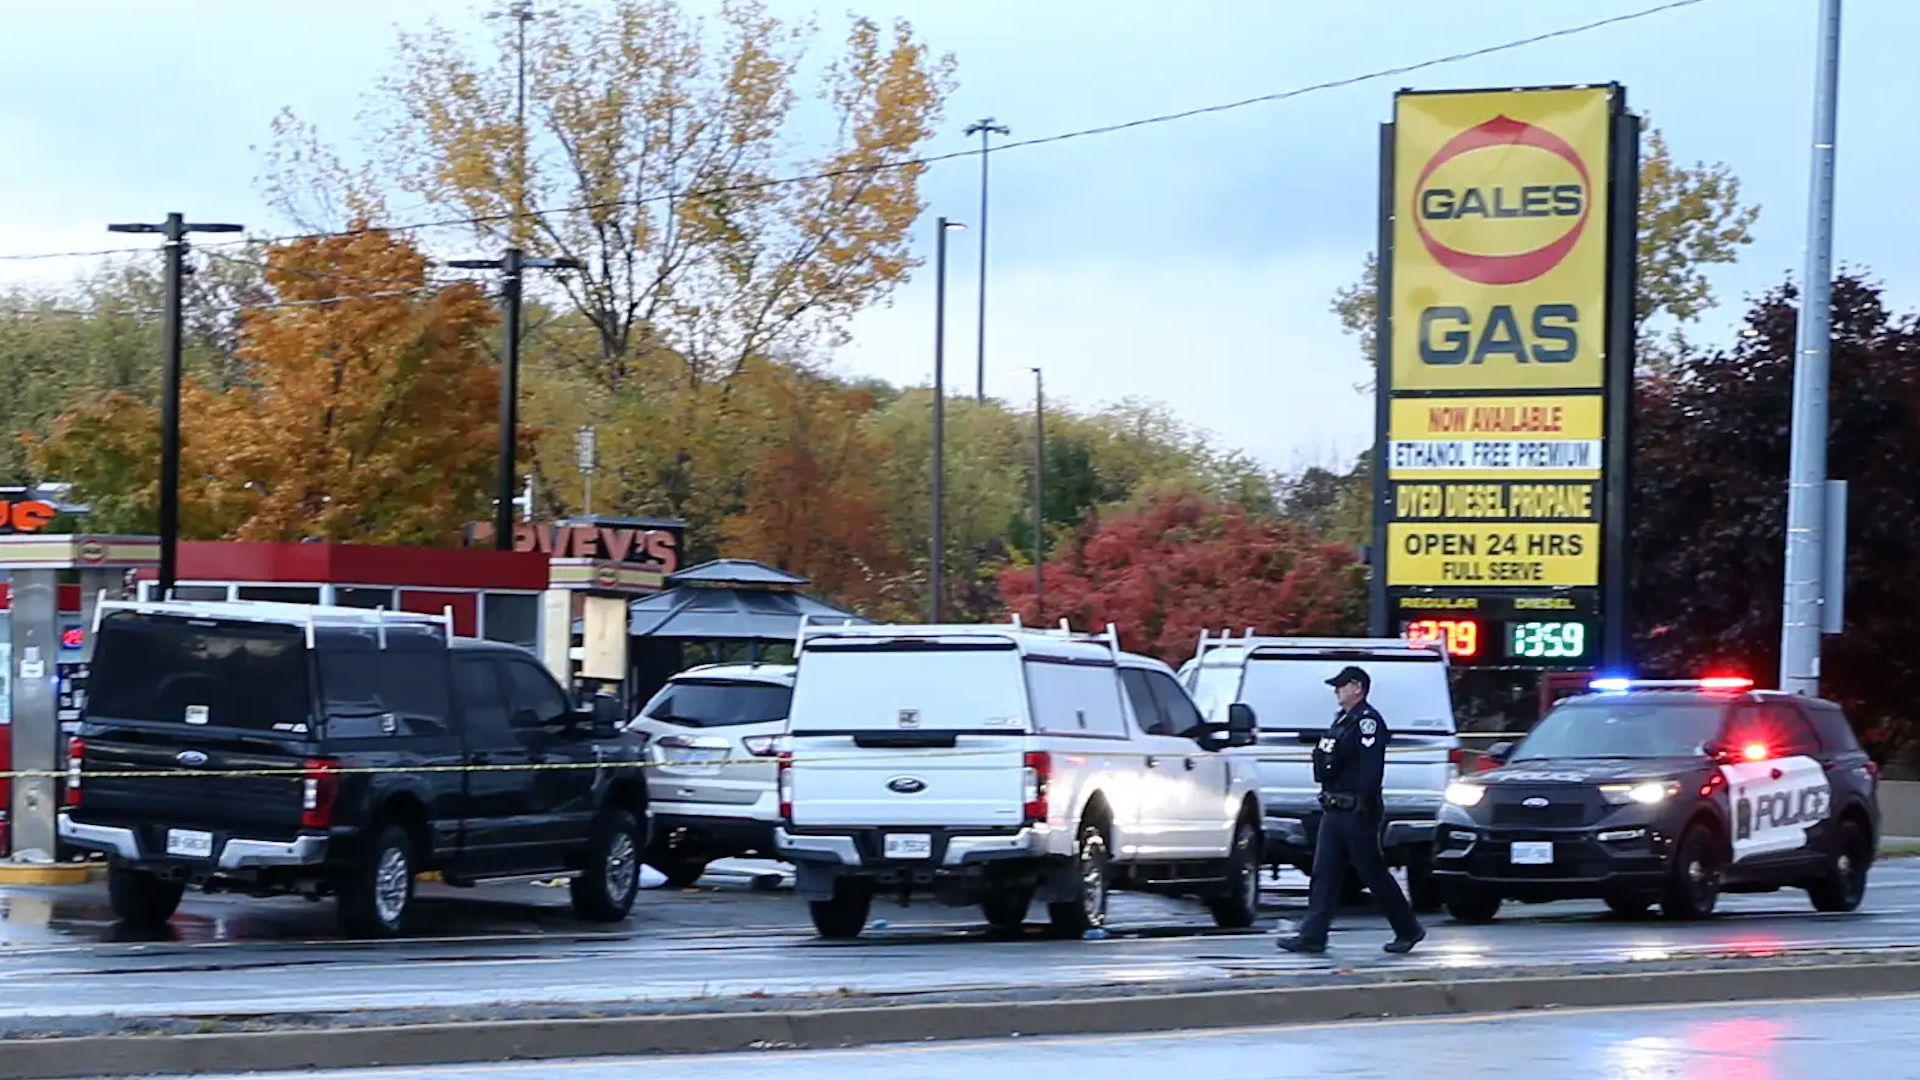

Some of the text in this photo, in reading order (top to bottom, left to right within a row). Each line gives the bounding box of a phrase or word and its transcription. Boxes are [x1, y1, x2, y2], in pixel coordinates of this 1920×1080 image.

[1422, 185, 1582, 219] GALES
[1419, 303, 1580, 365] GAS
[1429, 406, 1563, 432] NOW AVAILABLE
[1396, 442, 1591, 467] ETHANOL FREE PREMIUM
[1396, 484, 1592, 518] DYED DIESEL PROPANE
[1405, 534, 1584, 556] OPEN 24 HRS
[1442, 562, 1544, 580] FULL SERVE
[1400, 598, 1575, 610] REGULAR DIESEL
[1515, 622, 1585, 657] 1359
[1755, 785, 1830, 831] POLICE
